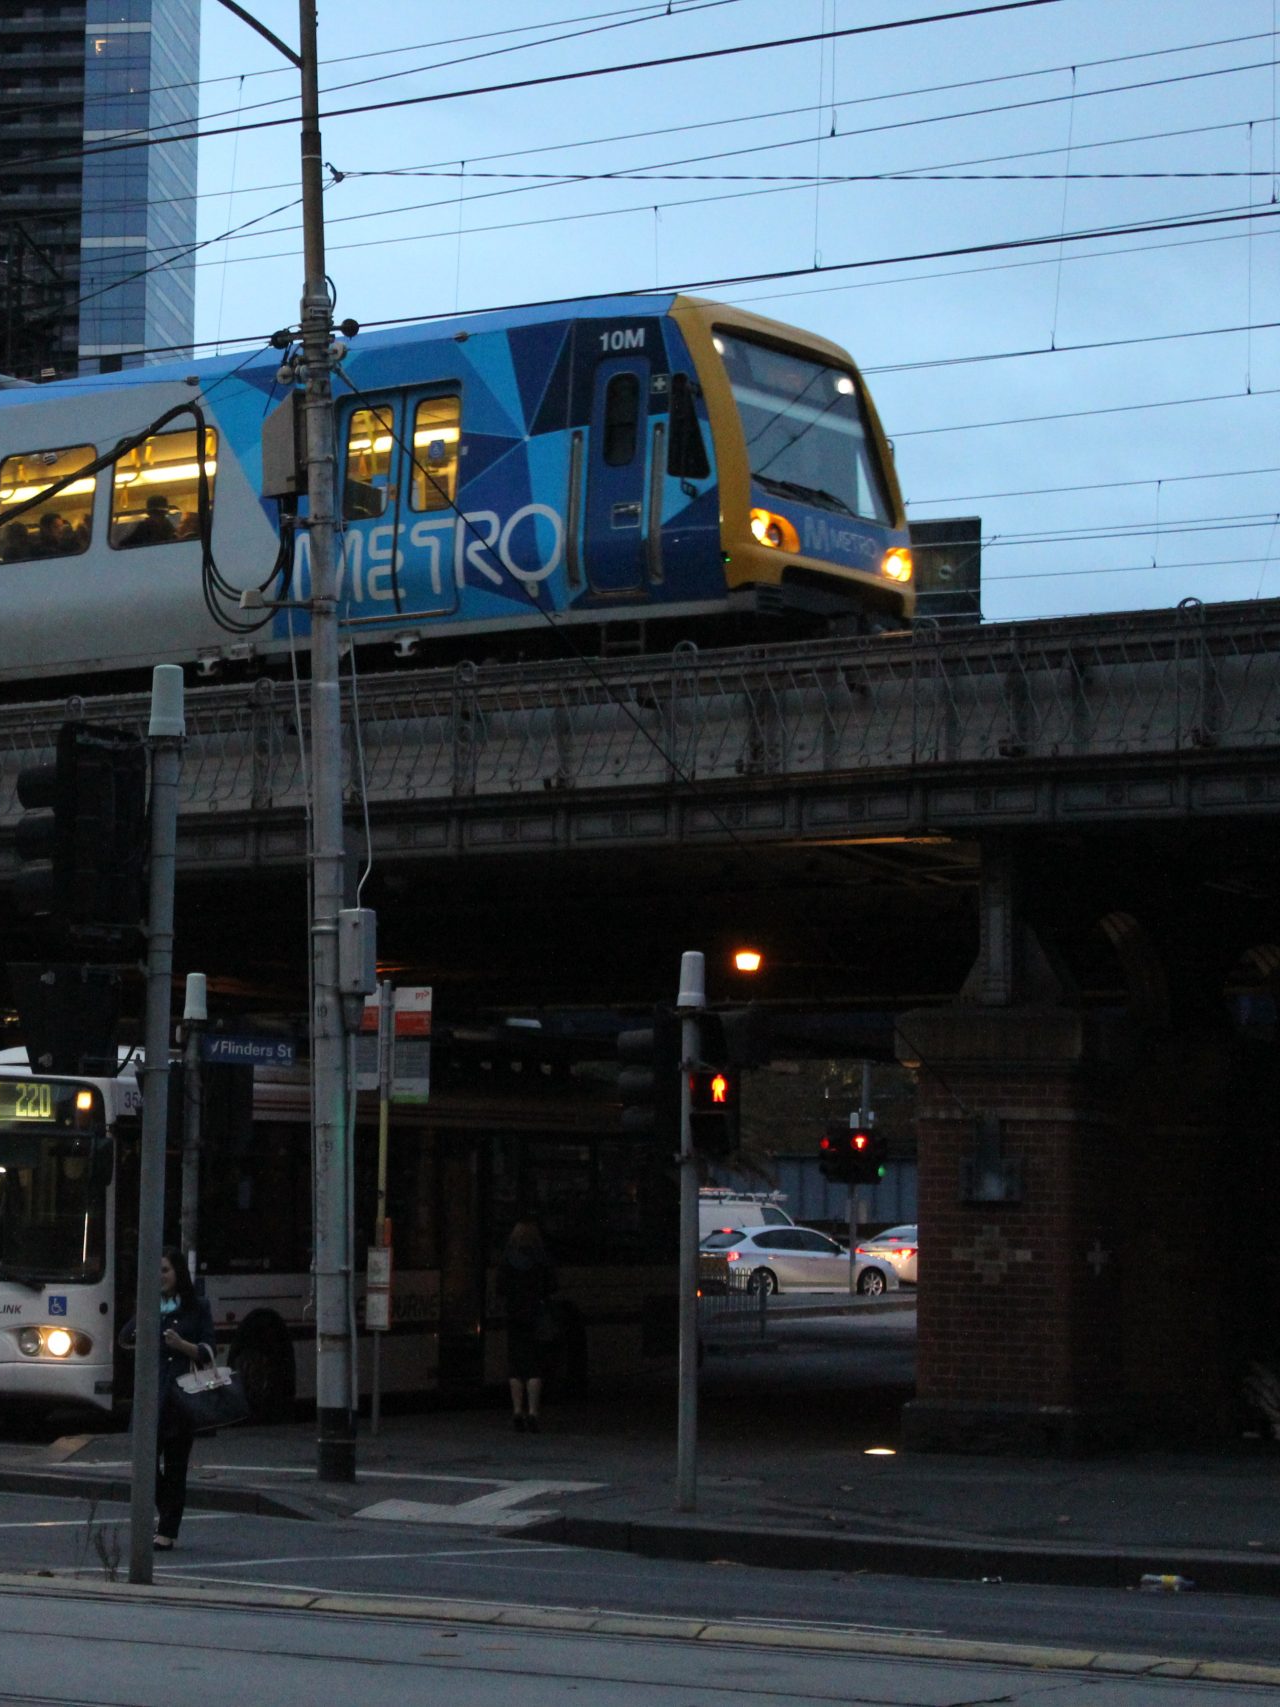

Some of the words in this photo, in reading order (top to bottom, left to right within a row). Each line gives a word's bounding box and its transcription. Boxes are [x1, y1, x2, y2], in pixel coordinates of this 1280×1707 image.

[599, 328, 646, 352] 10M
[292, 503, 562, 603] METRO
[220, 1040, 274, 1058] Flinders
[277, 1043, 292, 1058] St
[16, 1084, 51, 1117] 220
